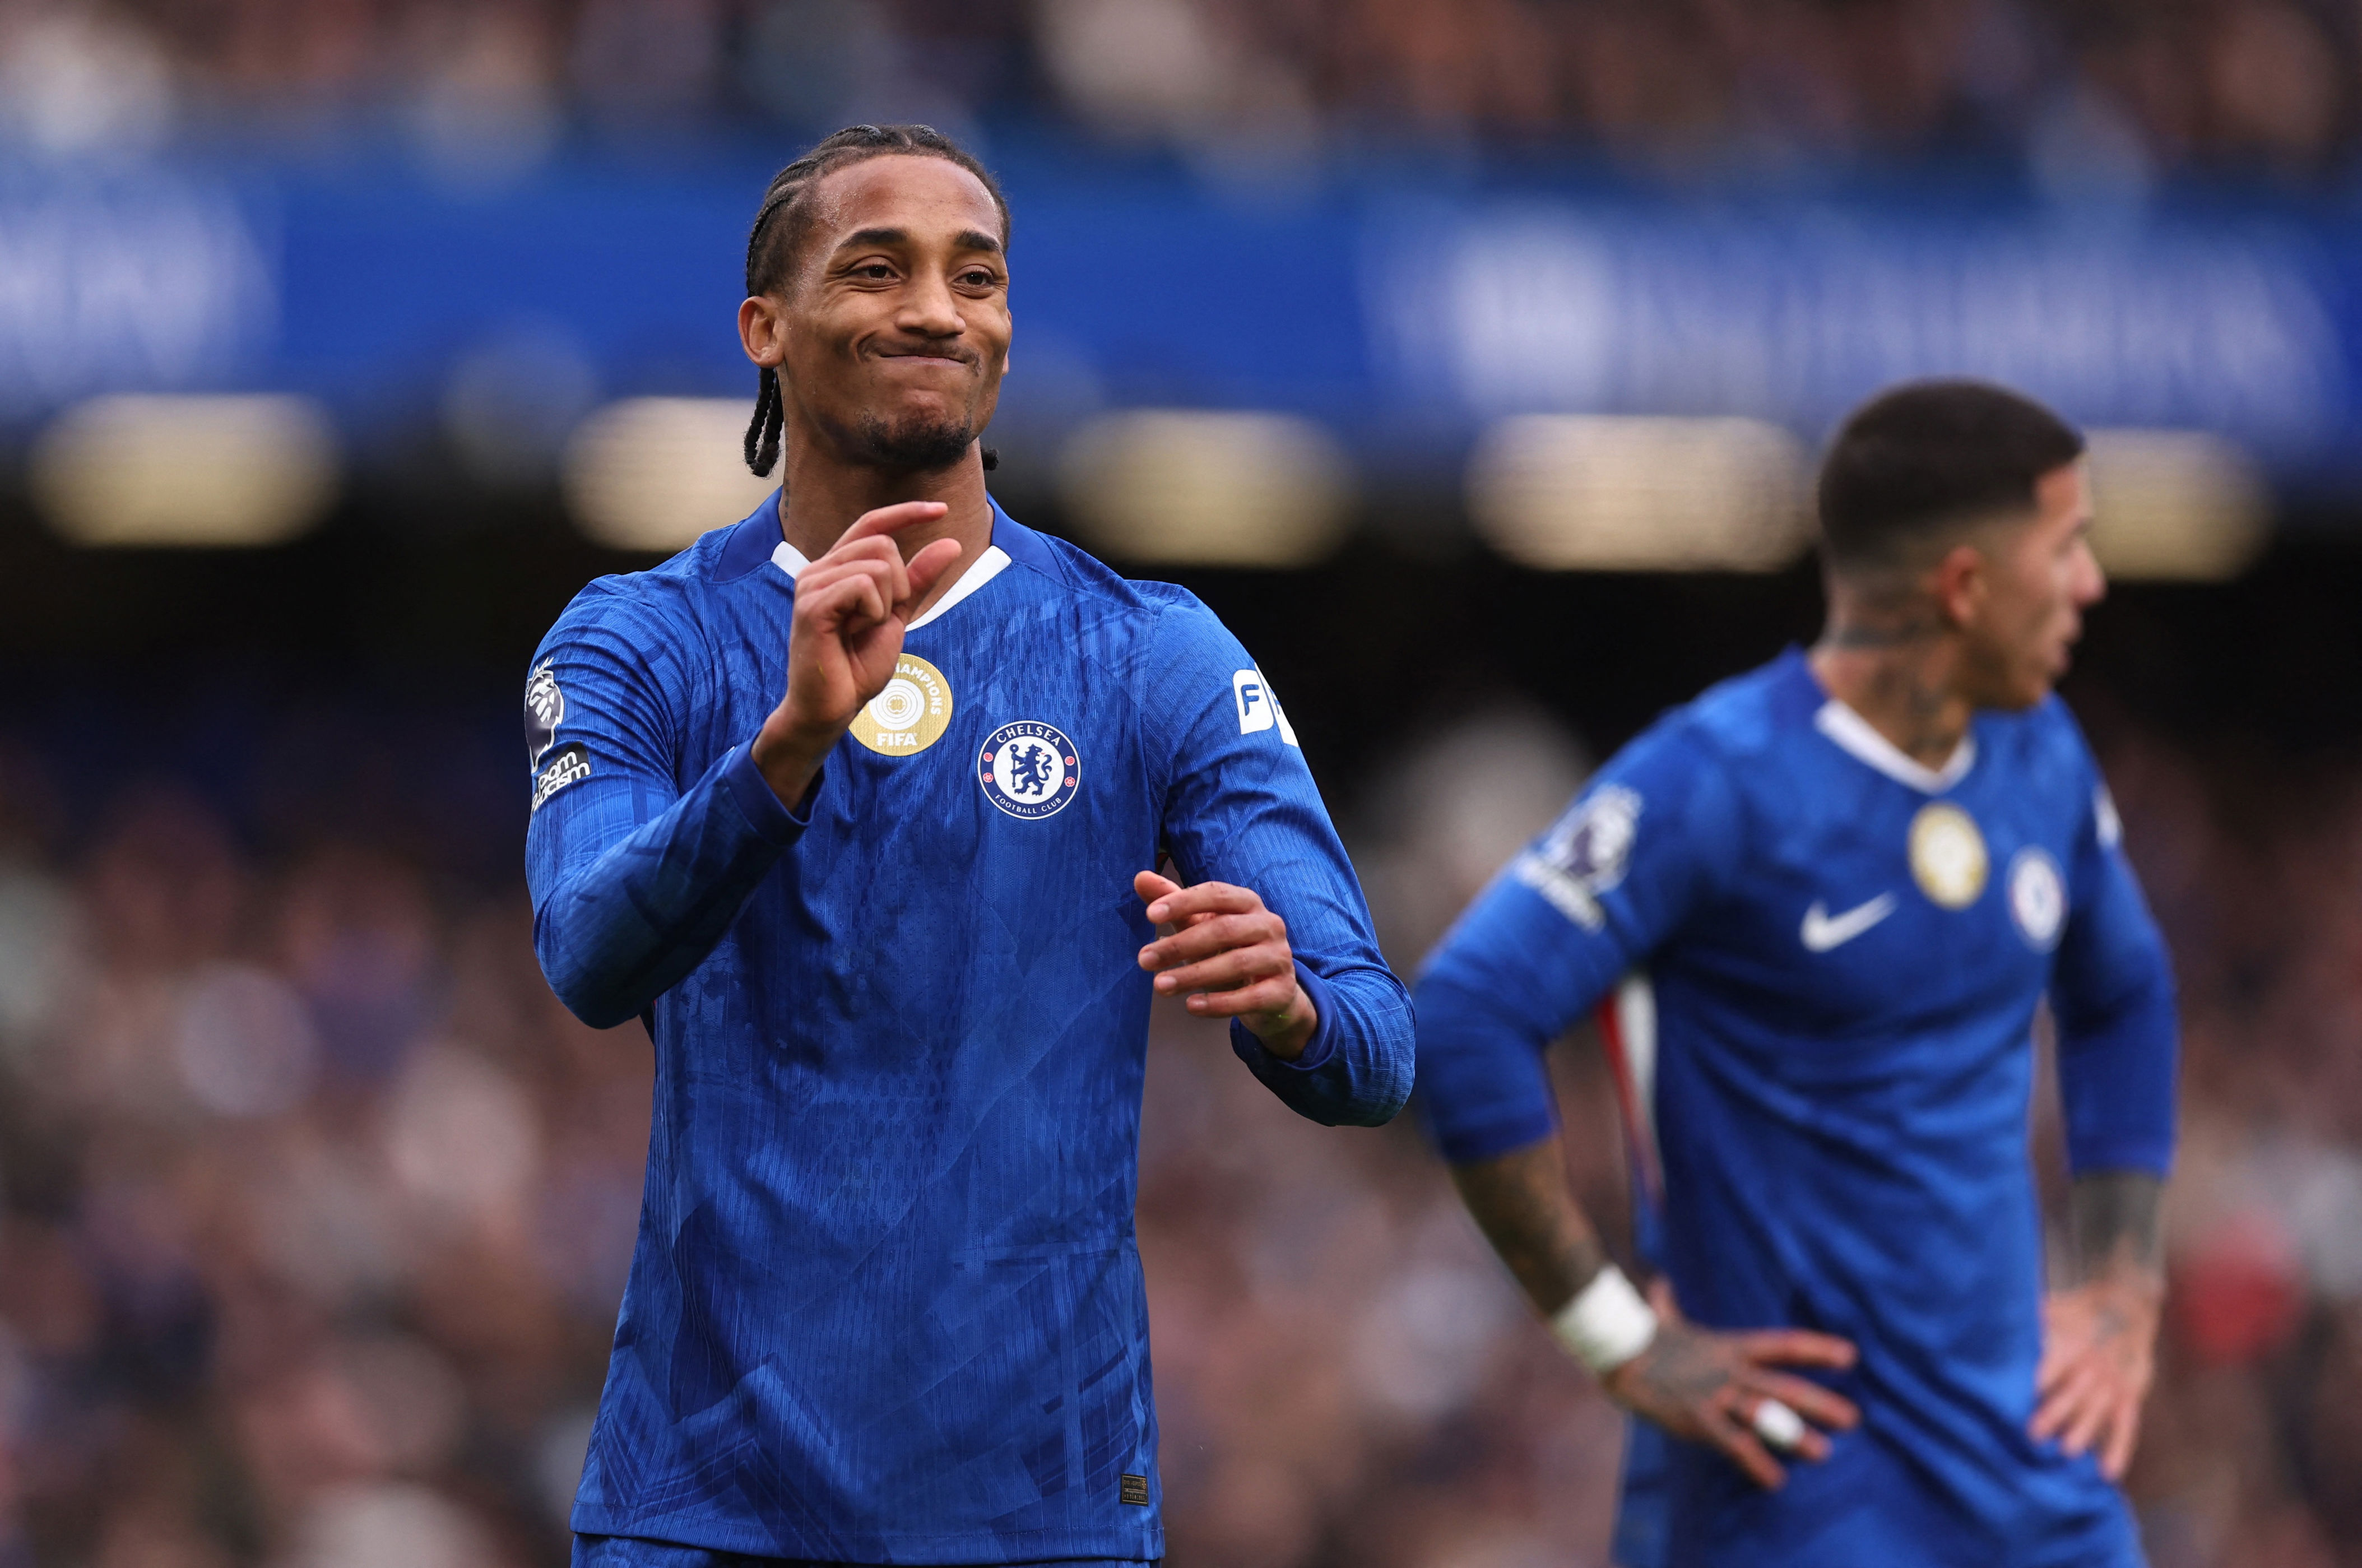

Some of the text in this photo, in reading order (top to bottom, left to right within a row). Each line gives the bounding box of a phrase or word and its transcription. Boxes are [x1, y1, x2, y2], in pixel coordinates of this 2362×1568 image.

[895, 662, 943, 715] AMPIONS
[876, 732, 917, 746] FIFA
[996, 725, 1061, 746] CHELSEA
[995, 794, 1062, 814] FOOTBALL CLUB
